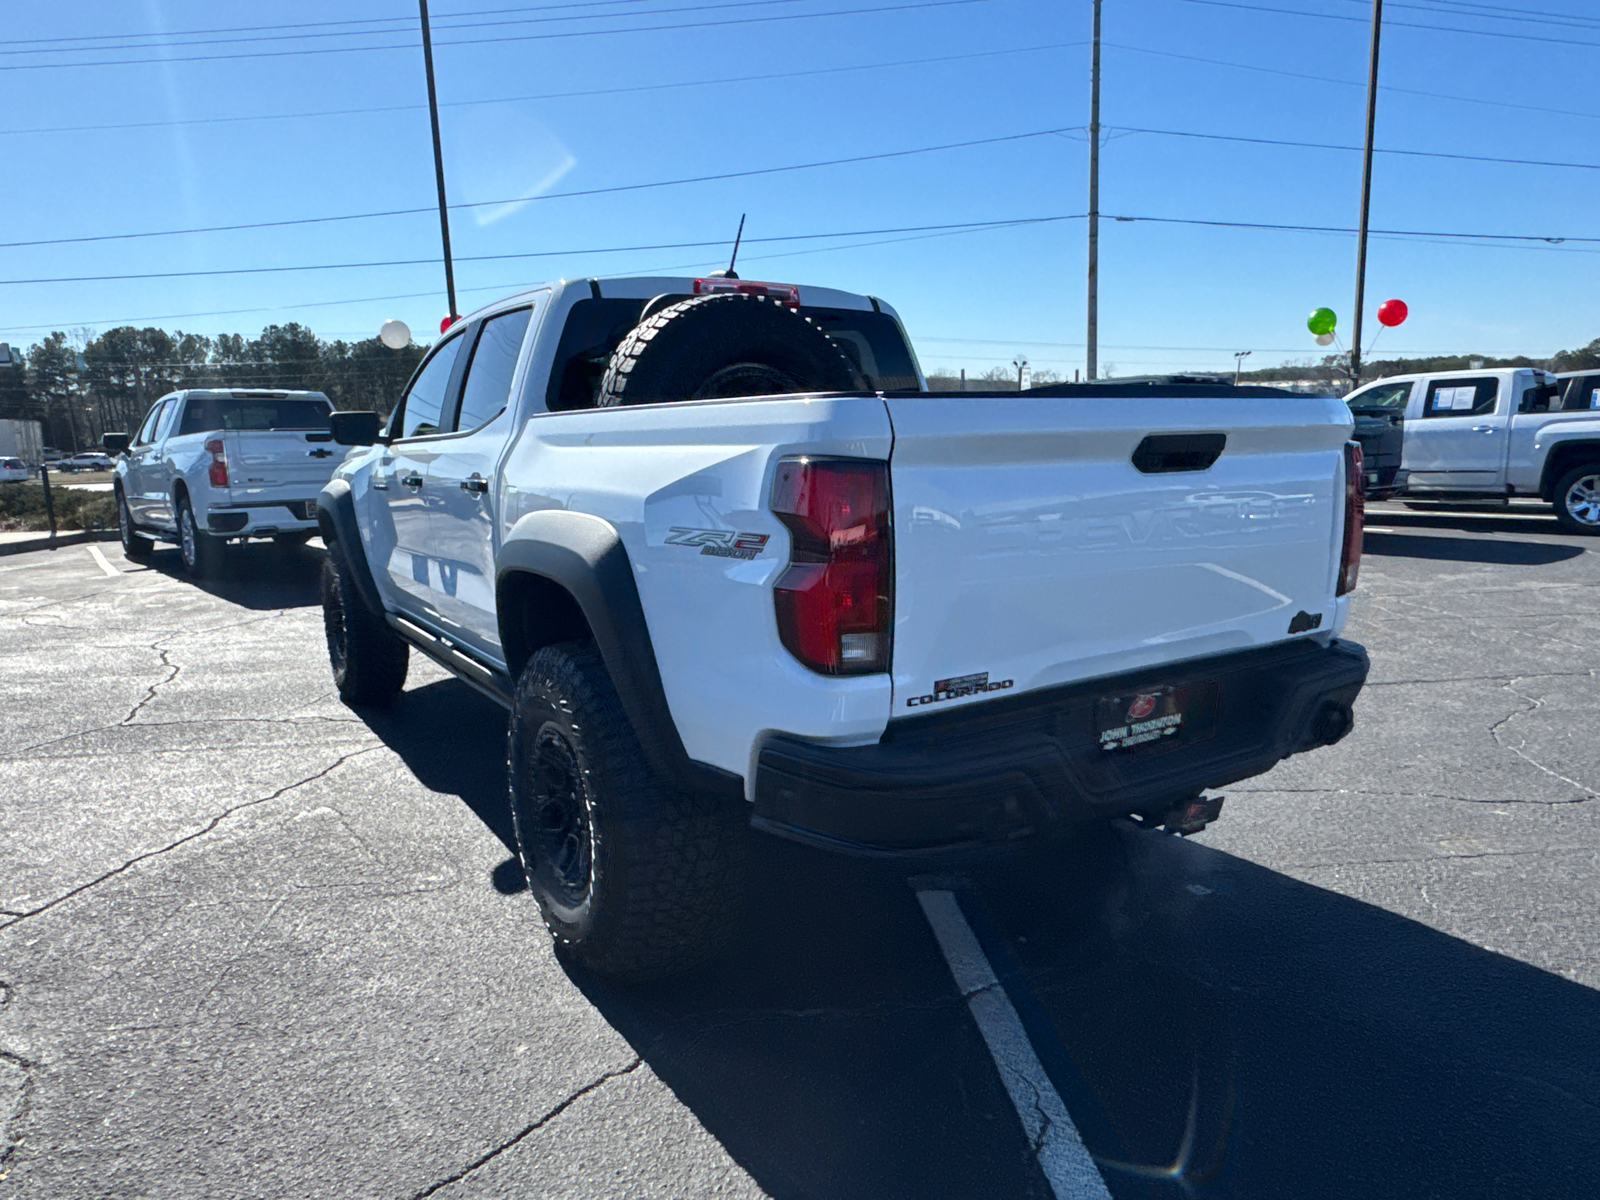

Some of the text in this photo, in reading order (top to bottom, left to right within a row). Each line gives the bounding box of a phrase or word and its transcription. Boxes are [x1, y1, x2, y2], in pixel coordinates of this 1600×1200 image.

[663, 526, 771, 553] ZR2
[700, 545, 758, 560] BISON
[906, 679, 1014, 707] COLORADO
[1099, 726, 1130, 743] JOHN
